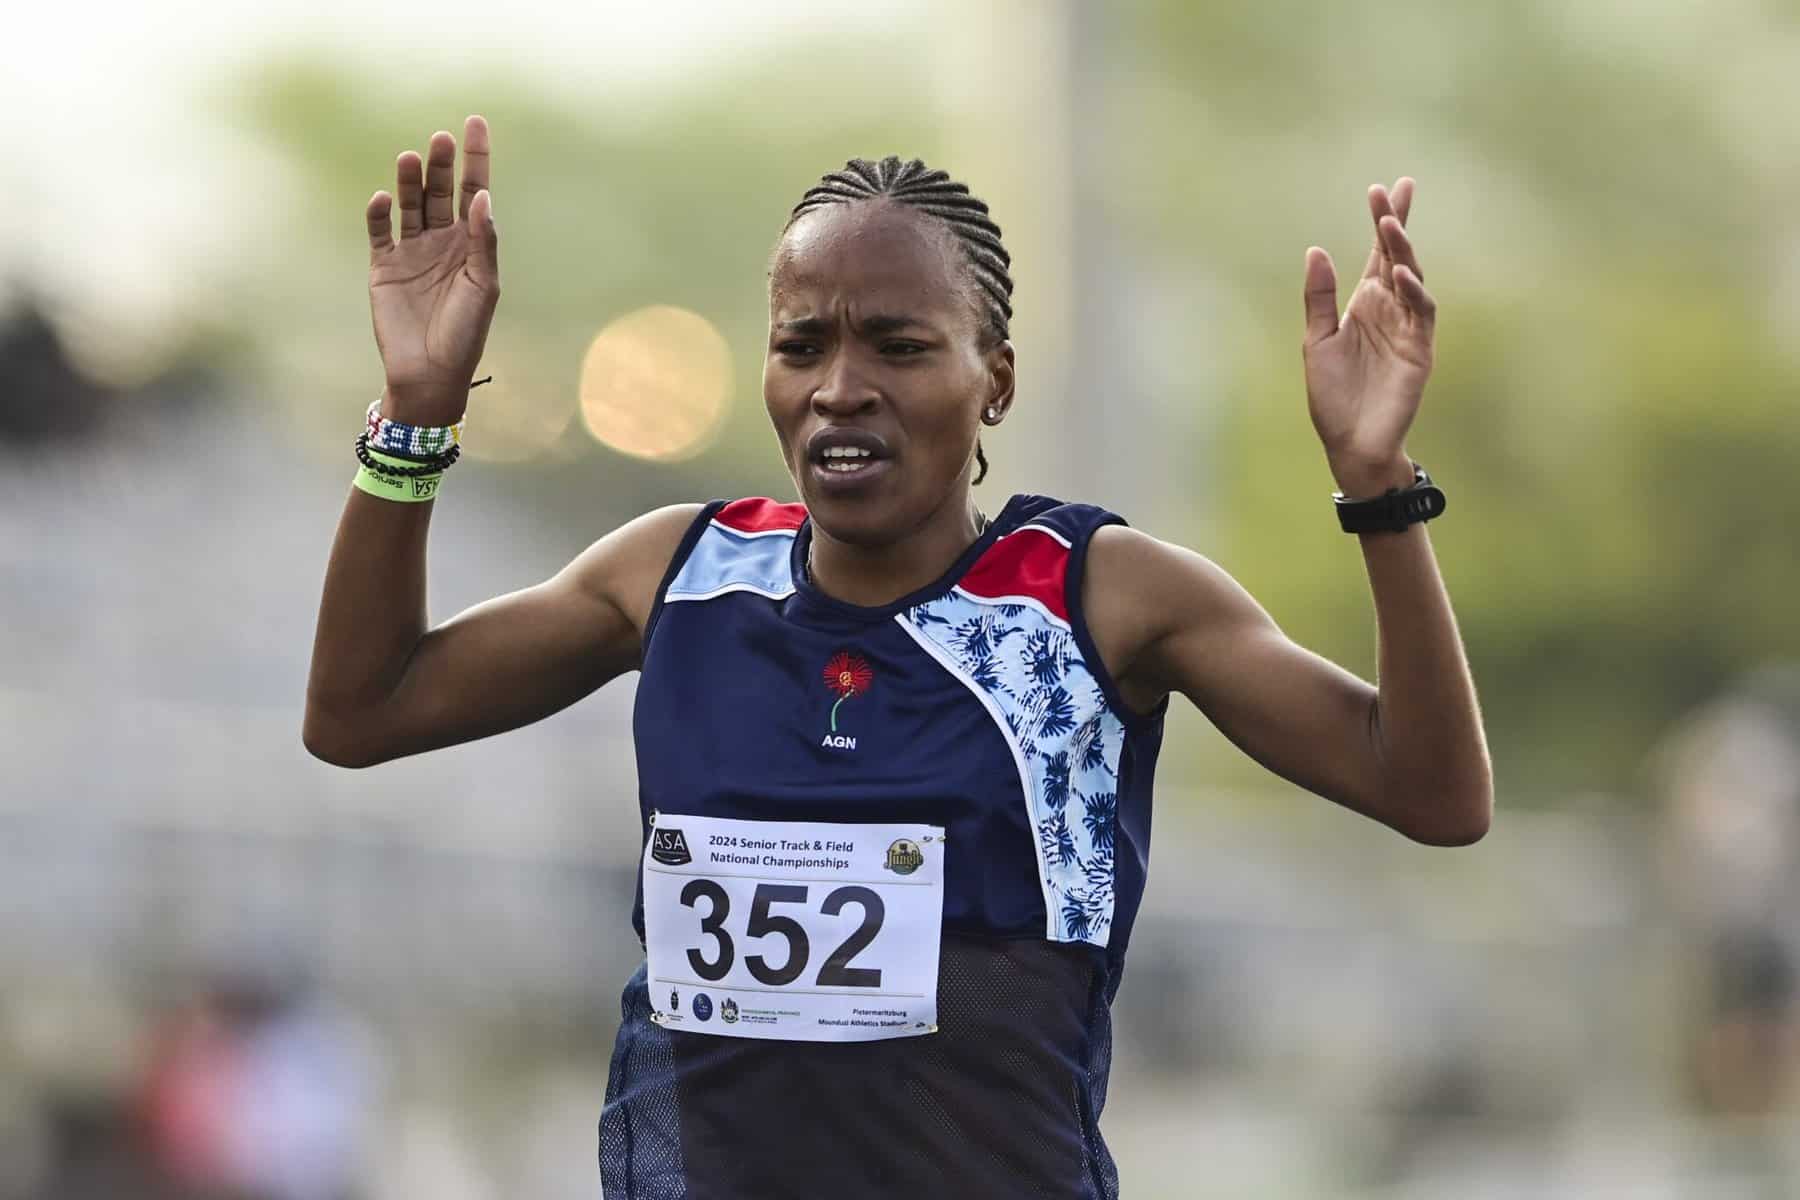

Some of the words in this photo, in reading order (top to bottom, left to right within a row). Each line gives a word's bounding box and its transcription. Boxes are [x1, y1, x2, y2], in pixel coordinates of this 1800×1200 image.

[822, 735, 856, 749] AGN
[655, 831, 685, 851] ASA
[709, 835, 737, 847] 2024
[740, 838, 777, 850] Senior
[780, 840, 810, 851] Track
[813, 841, 822, 851] &
[826, 841, 853, 852] Field
[710, 852, 759, 865] National
[762, 855, 849, 869] Championships
[680, 879, 885, 988] 352
